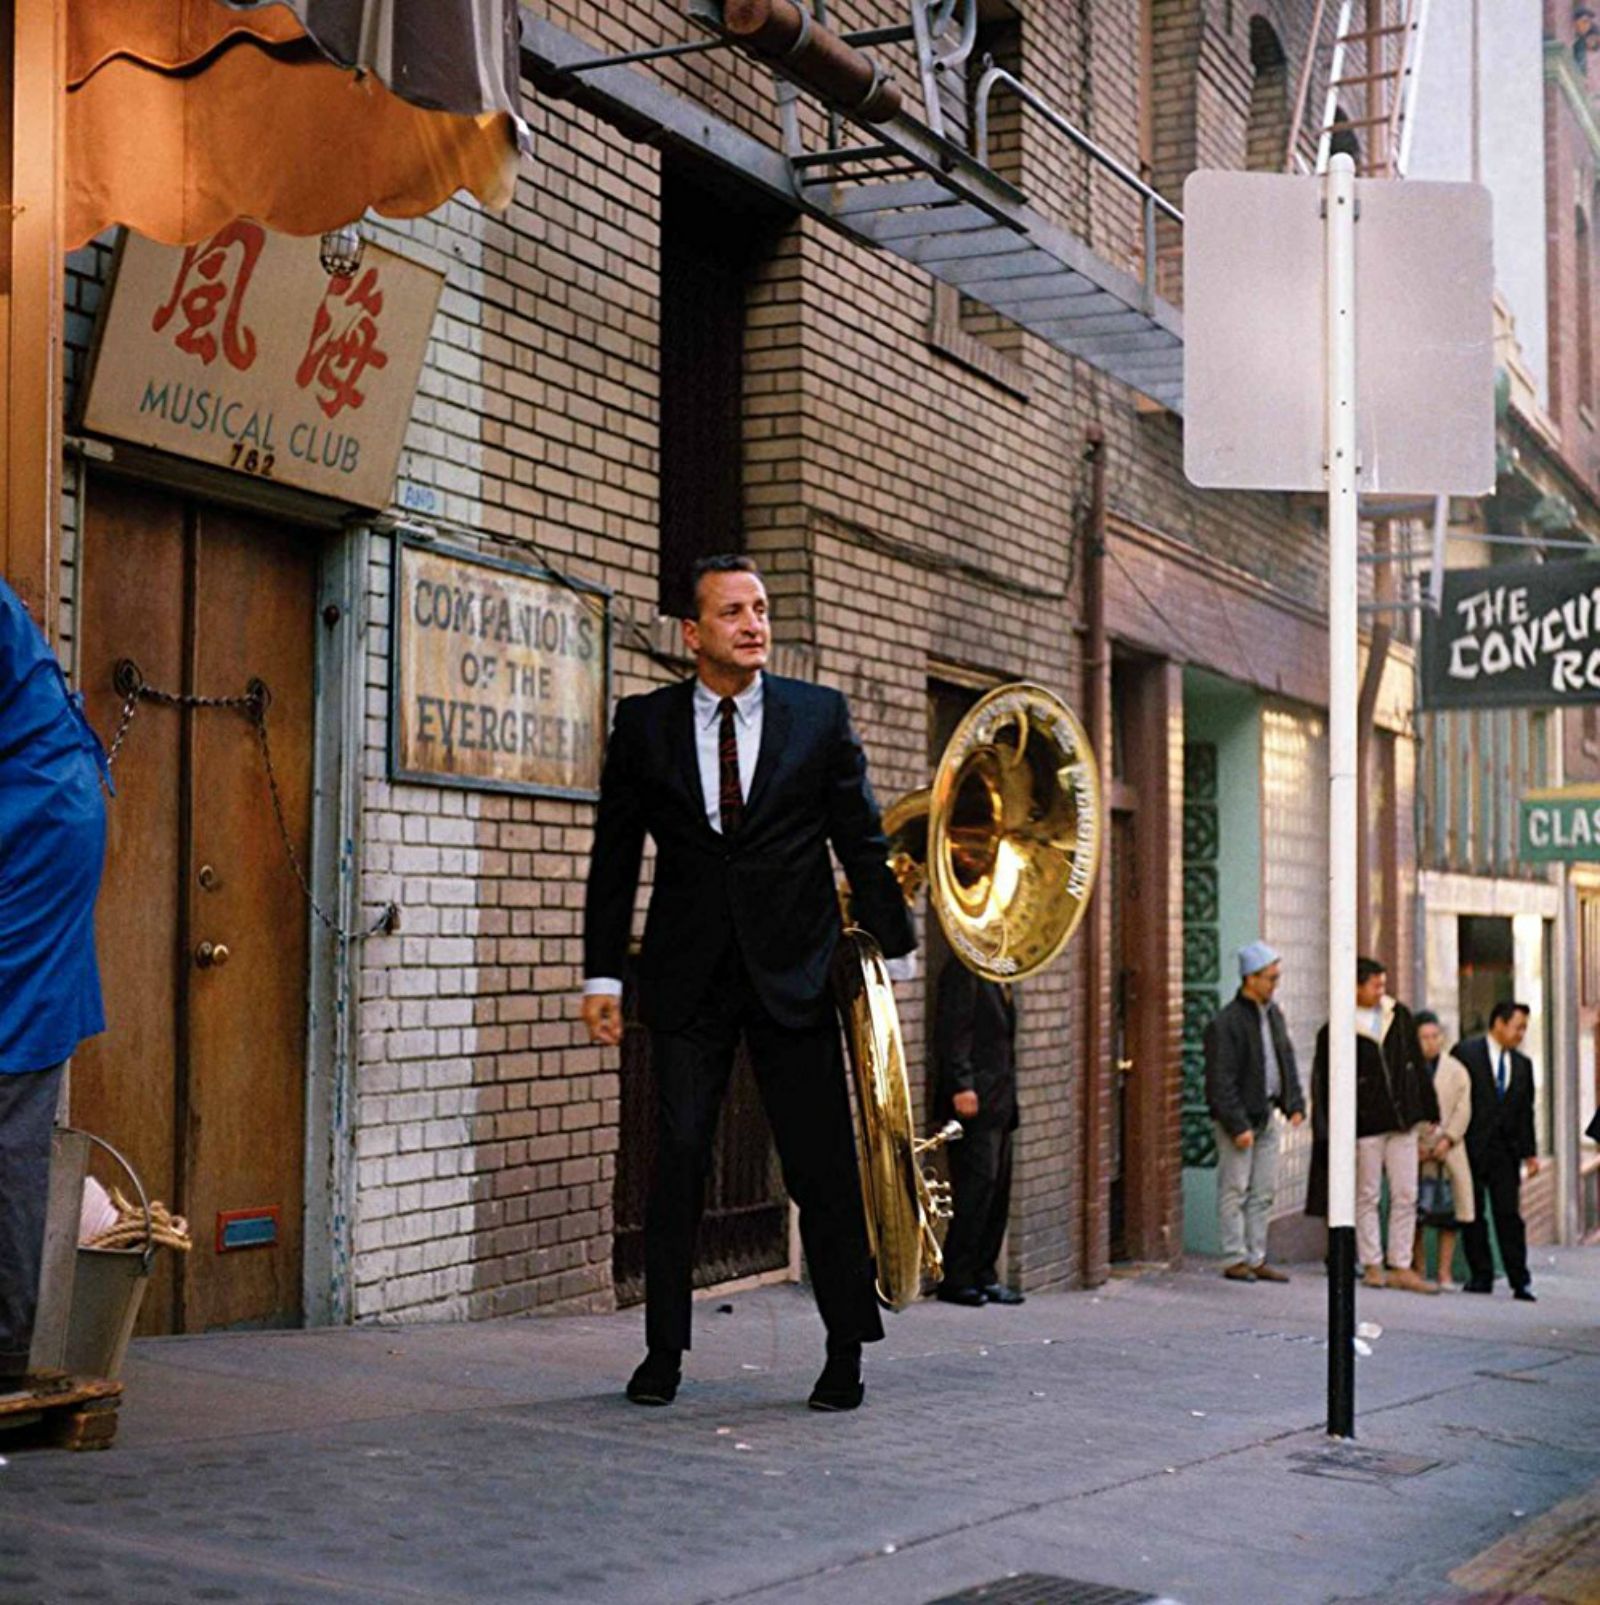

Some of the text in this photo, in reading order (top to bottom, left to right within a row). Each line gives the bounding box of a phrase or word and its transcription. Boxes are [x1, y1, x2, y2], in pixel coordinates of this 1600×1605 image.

[139, 379, 361, 474] MUSICAL CLUB
[1457, 586, 1529, 631] THE
[460, 652, 552, 699] OF THE
[416, 695, 590, 763] EVERGREEN
